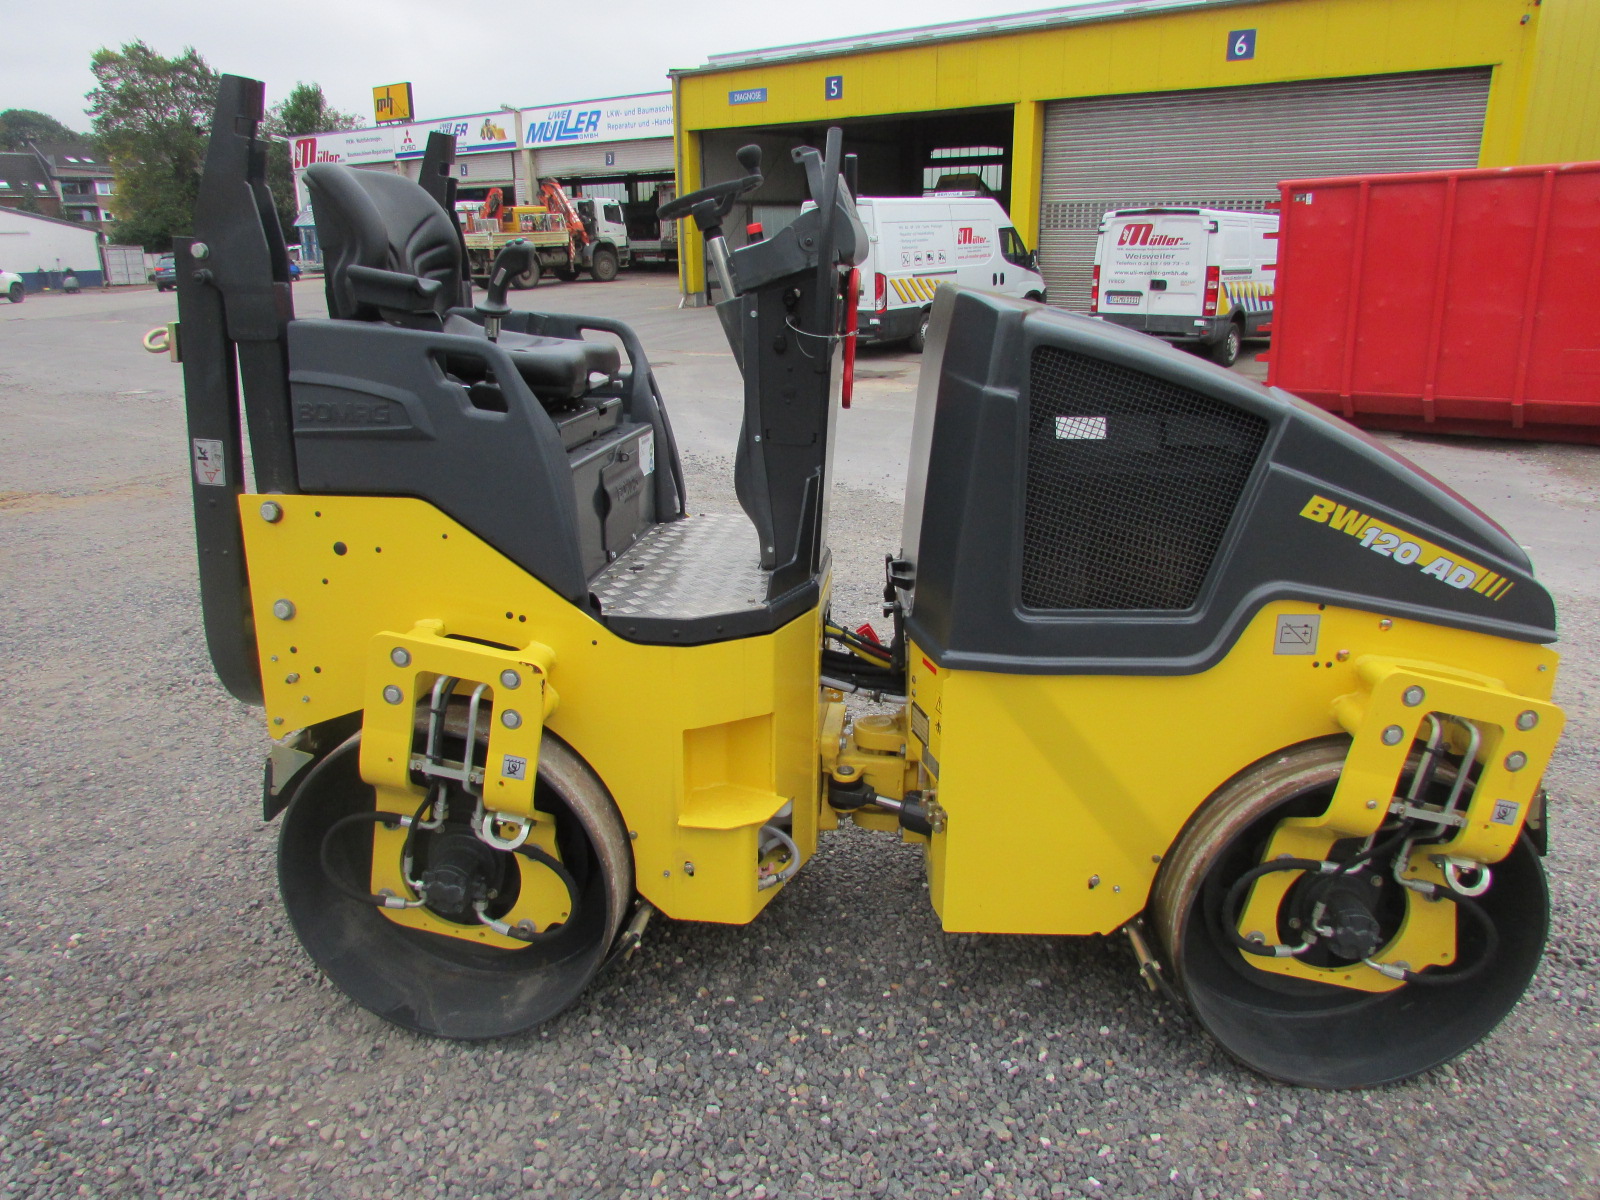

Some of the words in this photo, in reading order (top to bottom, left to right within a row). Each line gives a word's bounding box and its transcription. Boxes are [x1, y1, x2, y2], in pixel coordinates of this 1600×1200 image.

[1234, 34, 1247, 56] 6
[830, 80, 838, 97] 5
[734, 91, 762, 102] DIAGNOSE
[548, 110, 568, 120] UWE
[606, 110, 622, 118] LKW-
[624, 107, 636, 116] und
[525, 109, 602, 144] MÜLLER
[607, 122, 637, 131] Reparatur
[638, 119, 650, 128] und
[607, 154, 612, 164] 3
[461, 165, 467, 175] 2
[957, 227, 987, 245] Müller
[1117, 223, 1184, 246] Müller
[1125, 252, 1176, 260] Weisweiler
[300, 401, 390, 422] BOMAG
[1359, 526, 1422, 566] 120
[1420, 556, 1477, 590] AD
